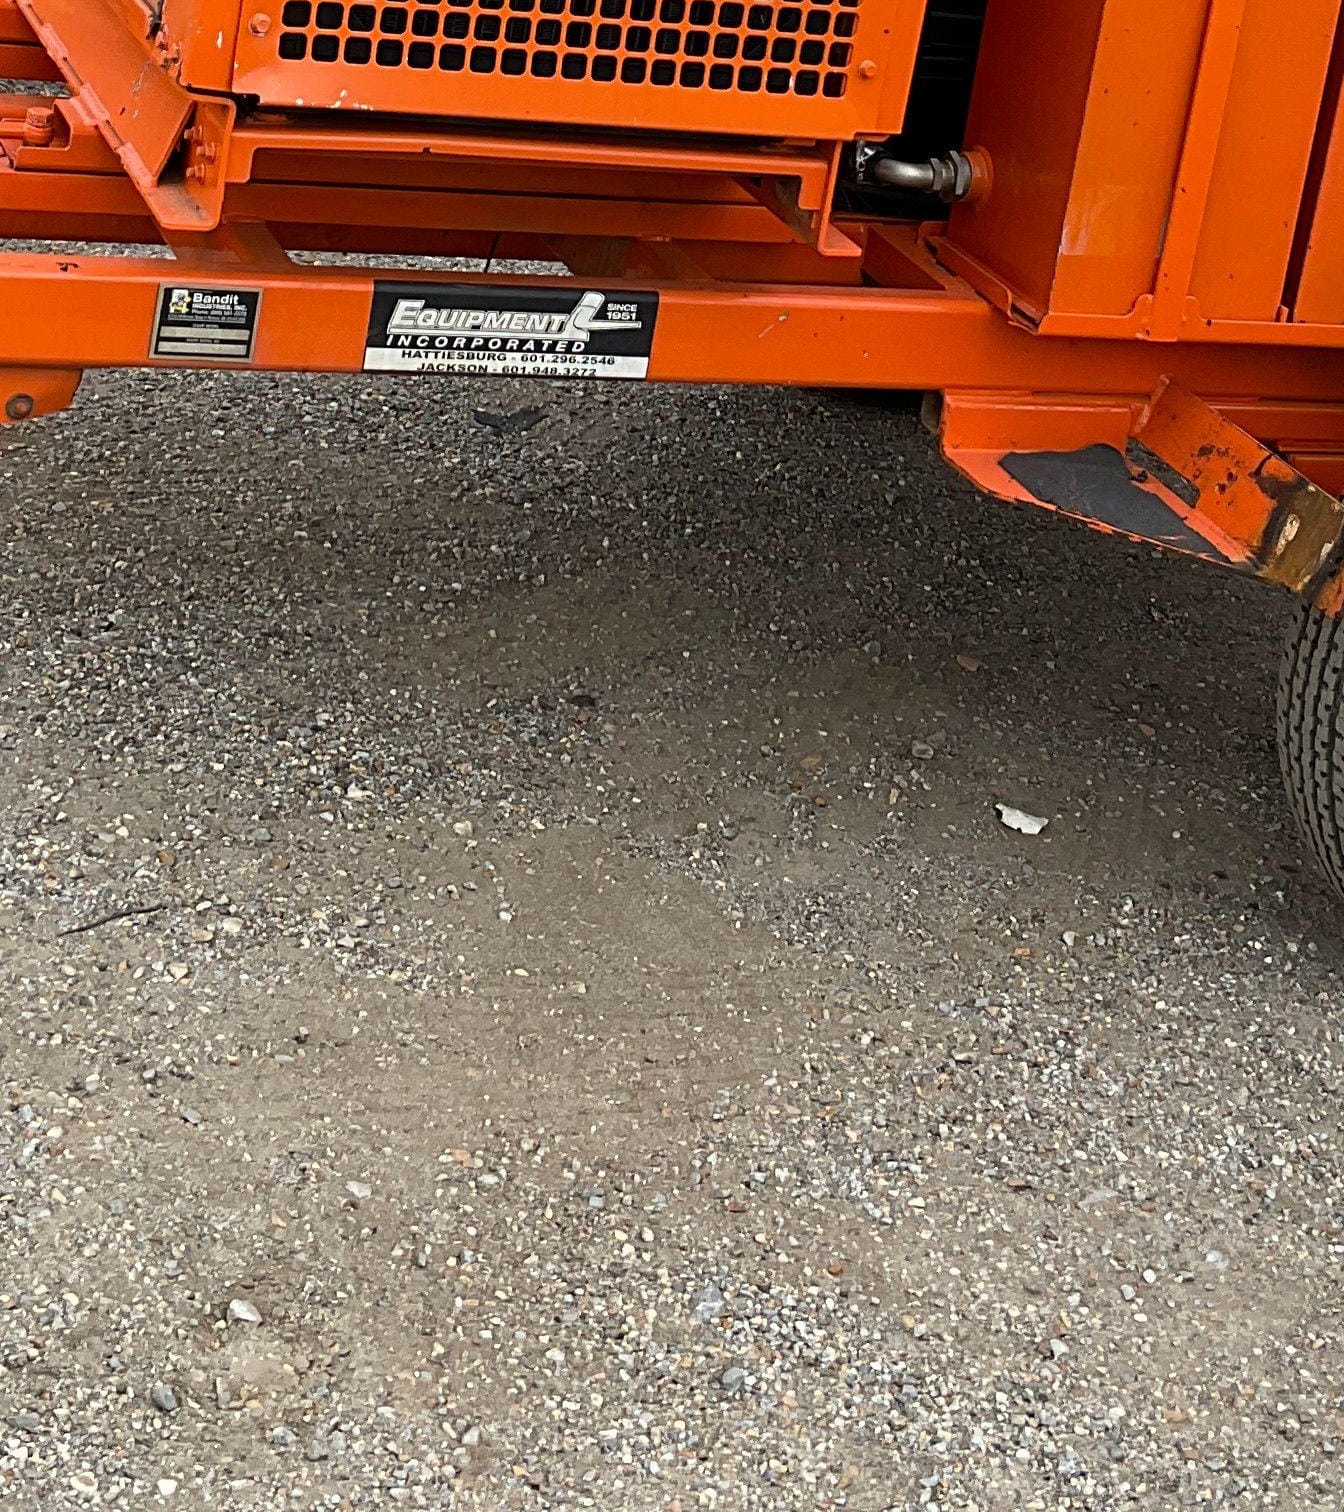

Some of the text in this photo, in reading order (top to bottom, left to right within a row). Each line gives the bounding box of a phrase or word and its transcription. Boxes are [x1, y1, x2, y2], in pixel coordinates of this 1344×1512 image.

[192, 292, 240, 305] Bandit
[607, 302, 638, 312] SINCE
[388, 299, 570, 333] EQUIPMENT
[607, 311, 637, 321] 1951
[386, 334, 586, 354] INCORPORATED
[401, 349, 507, 363] HATTIESBURG
[417, 362, 488, 374] JACKSON
